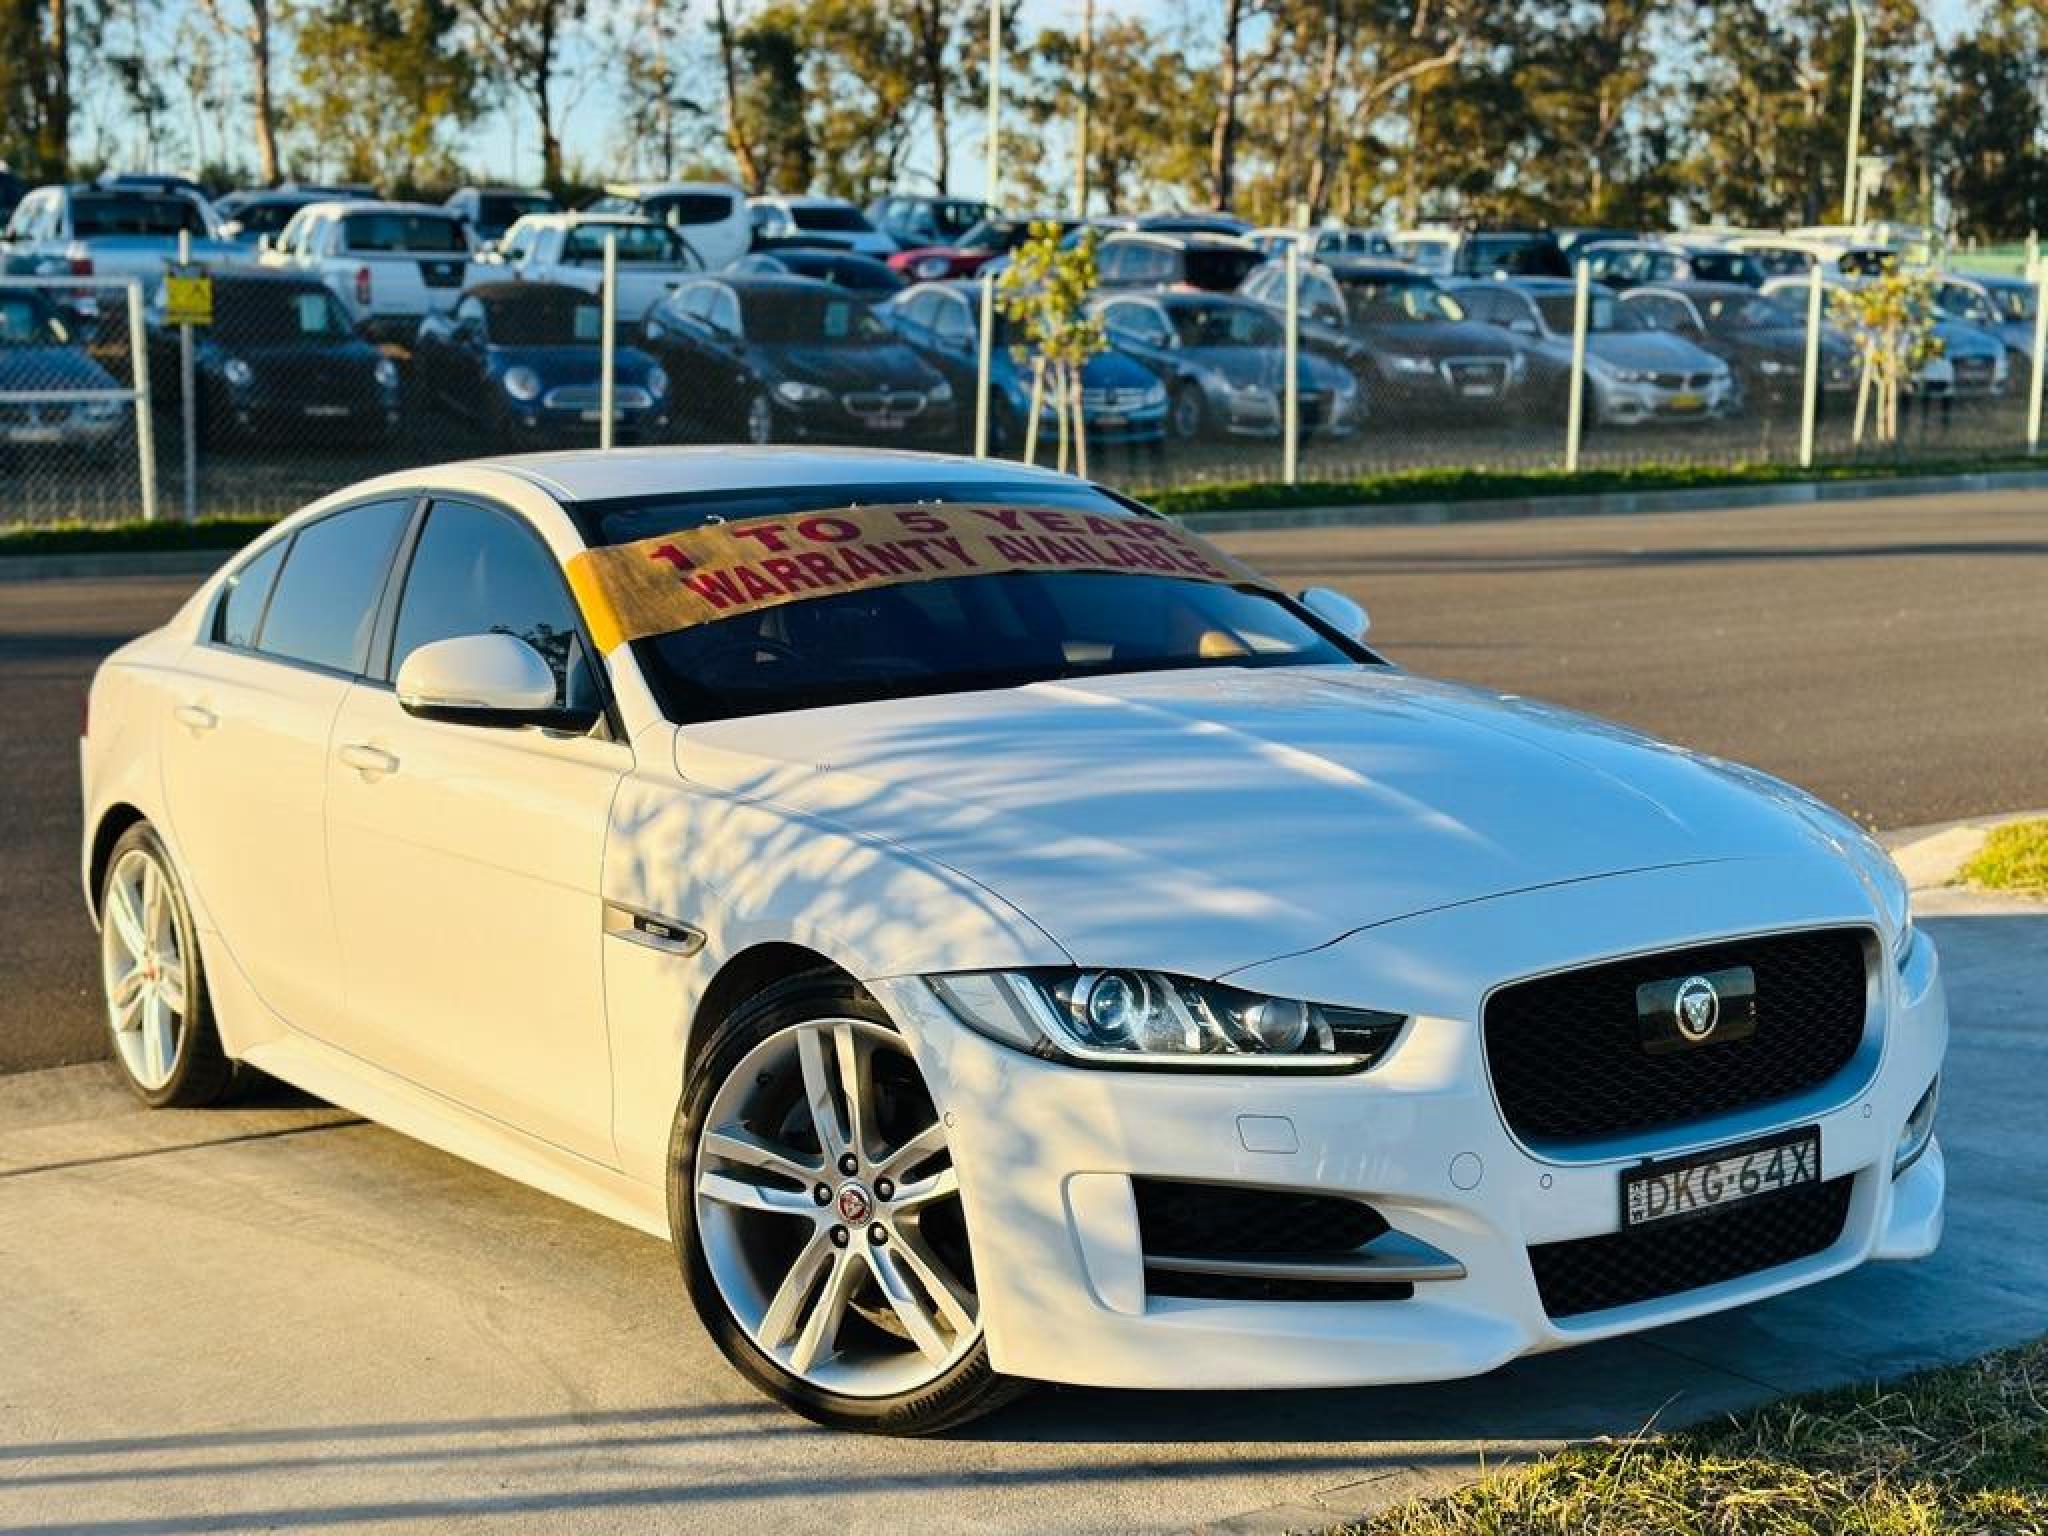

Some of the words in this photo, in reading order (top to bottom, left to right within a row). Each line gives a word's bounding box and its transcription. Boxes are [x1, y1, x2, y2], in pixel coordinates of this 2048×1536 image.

[649, 543, 696, 571] 1
[732, 524, 862, 552] TO
[894, 511, 949, 533] 5
[969, 509, 1184, 545] YEAR
[680, 535, 980, 609] WARRANTY
[985, 535, 1230, 578] AVAILABLE
